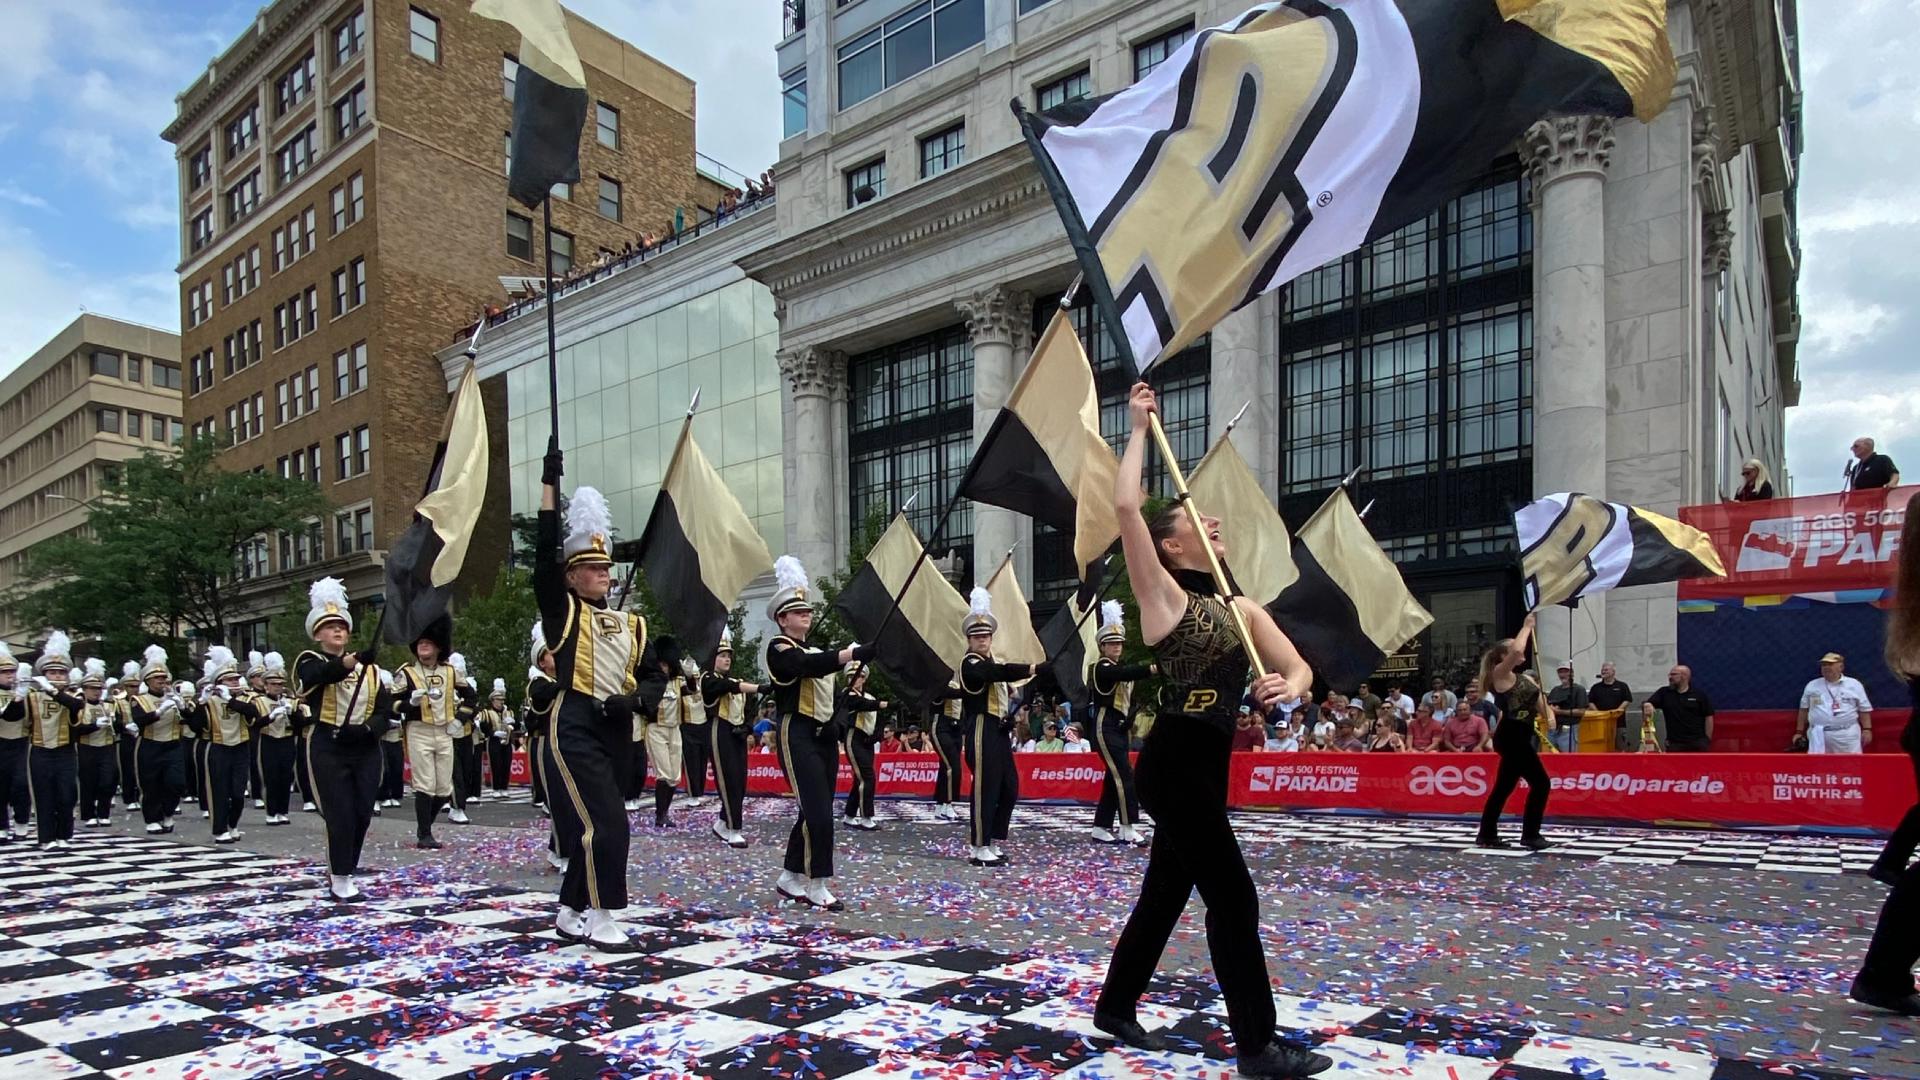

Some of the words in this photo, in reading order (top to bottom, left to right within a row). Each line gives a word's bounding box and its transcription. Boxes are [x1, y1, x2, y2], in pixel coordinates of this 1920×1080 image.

[1183, 689, 1217, 712] P
[1296, 766, 1313, 774] 500
[1315, 766, 1360, 775] FESTIVAL
[1773, 773, 1821, 785] Watch
[1826, 774, 1837, 785] it
[1842, 776, 1862, 785] on
[1274, 775, 1359, 793] PARADE
[1409, 765, 1487, 797] aes
[1550, 773, 1724, 796] es500parade
[1794, 787, 1841, 799] WTHR
